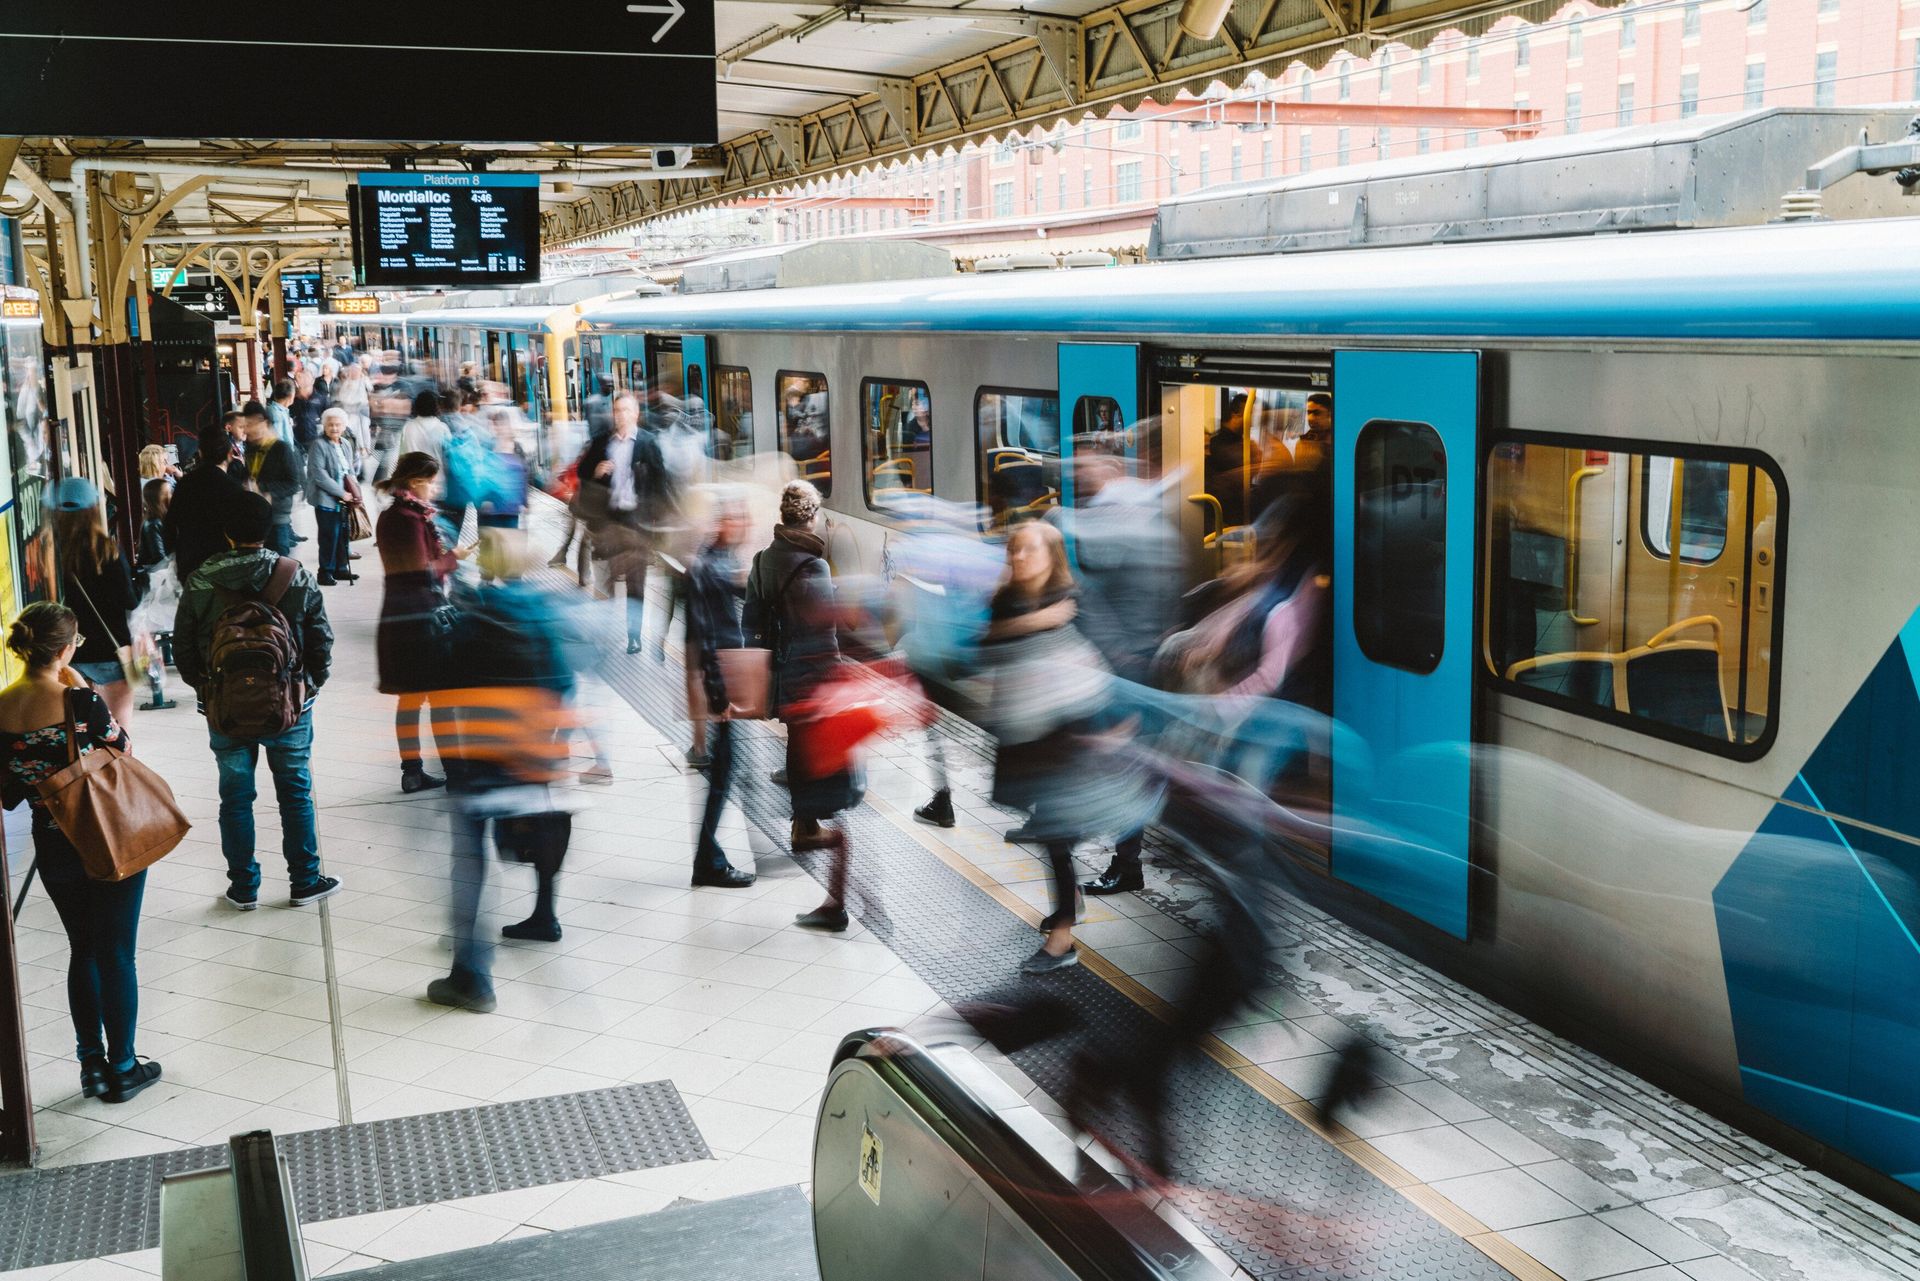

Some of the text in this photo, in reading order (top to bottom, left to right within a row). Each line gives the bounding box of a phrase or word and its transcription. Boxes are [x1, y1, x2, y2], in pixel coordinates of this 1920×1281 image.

[424, 174, 480, 185] Platform 8
[378, 190, 450, 202] Mordialloc
[471, 194, 492, 203] 4:46
